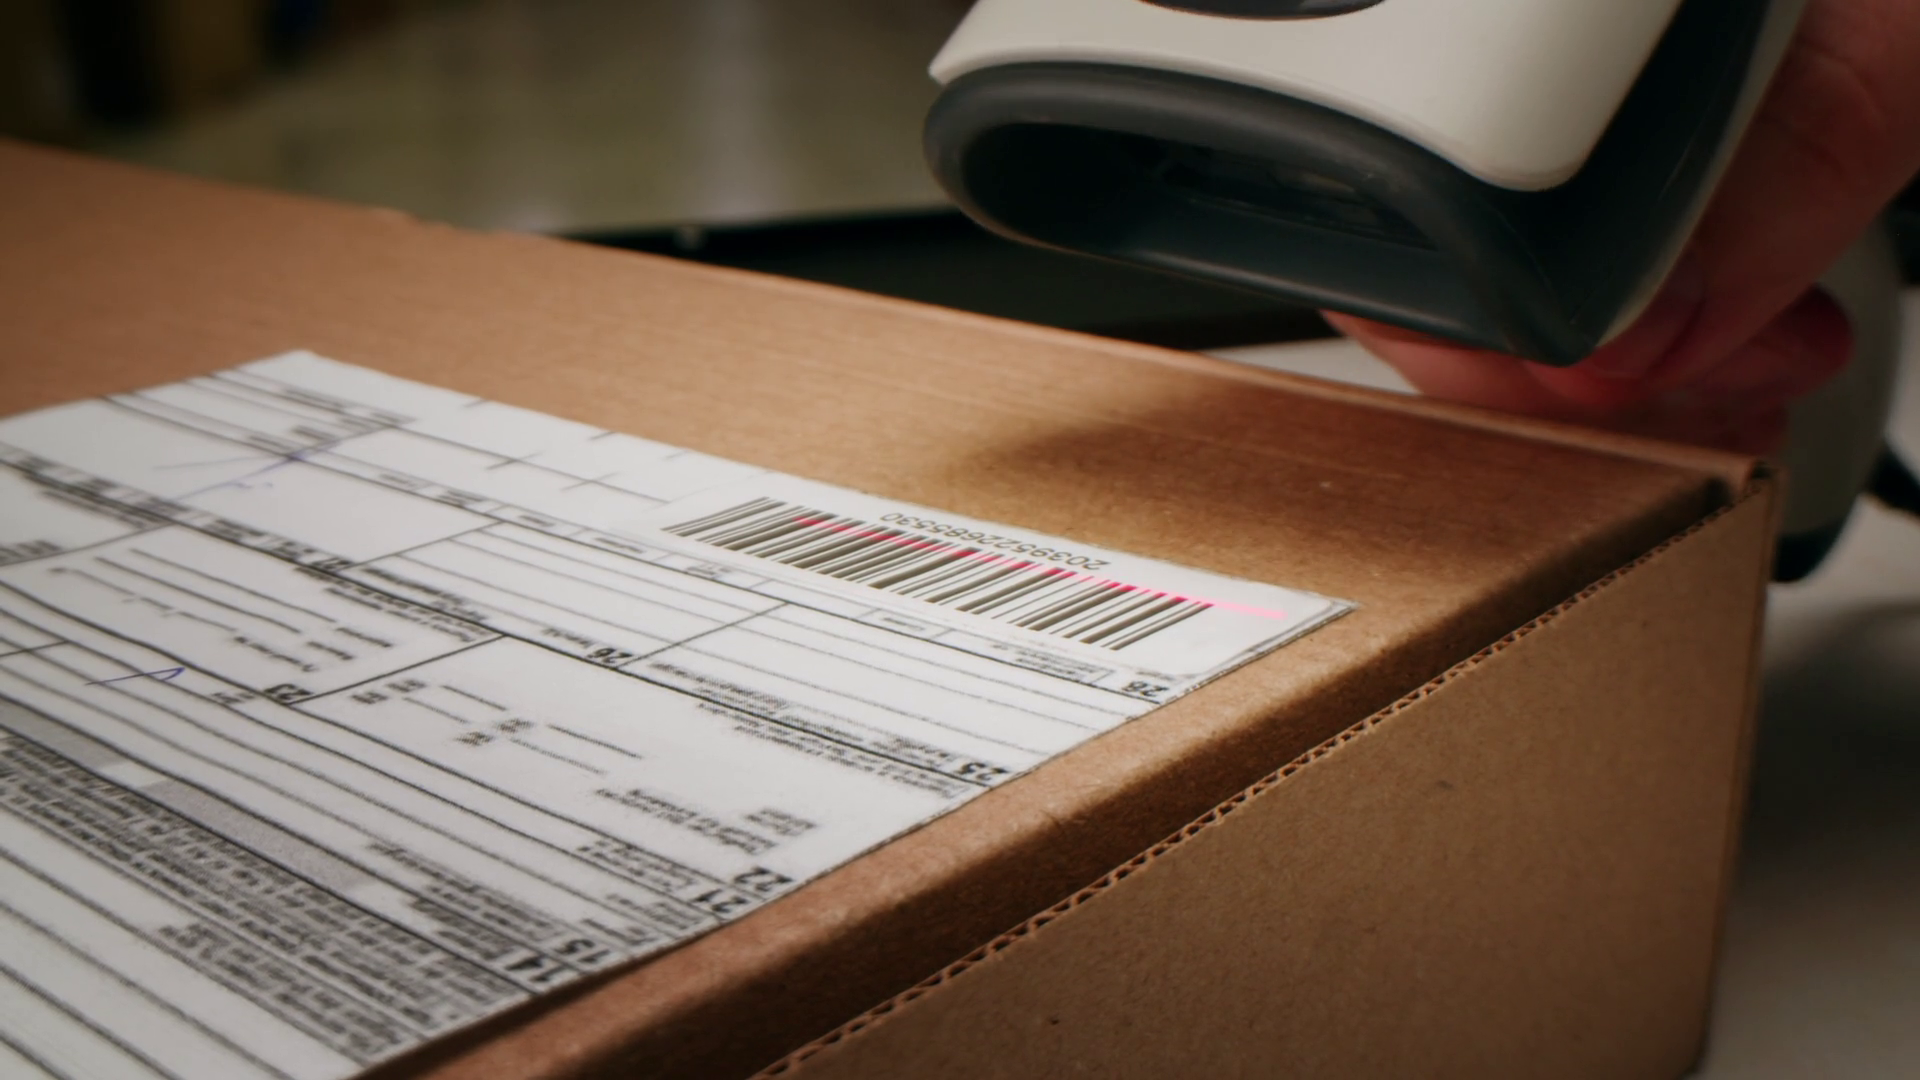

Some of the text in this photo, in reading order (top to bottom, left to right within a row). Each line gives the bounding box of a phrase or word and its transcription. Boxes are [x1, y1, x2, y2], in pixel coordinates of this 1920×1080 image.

[879, 512, 1111, 571] 2039522685530
[587, 648, 634, 665] 26
[733, 866, 794, 892] 22
[692, 889, 751, 913] 21
[555, 938, 611, 966] 15
[504, 955, 569, 983] 14
